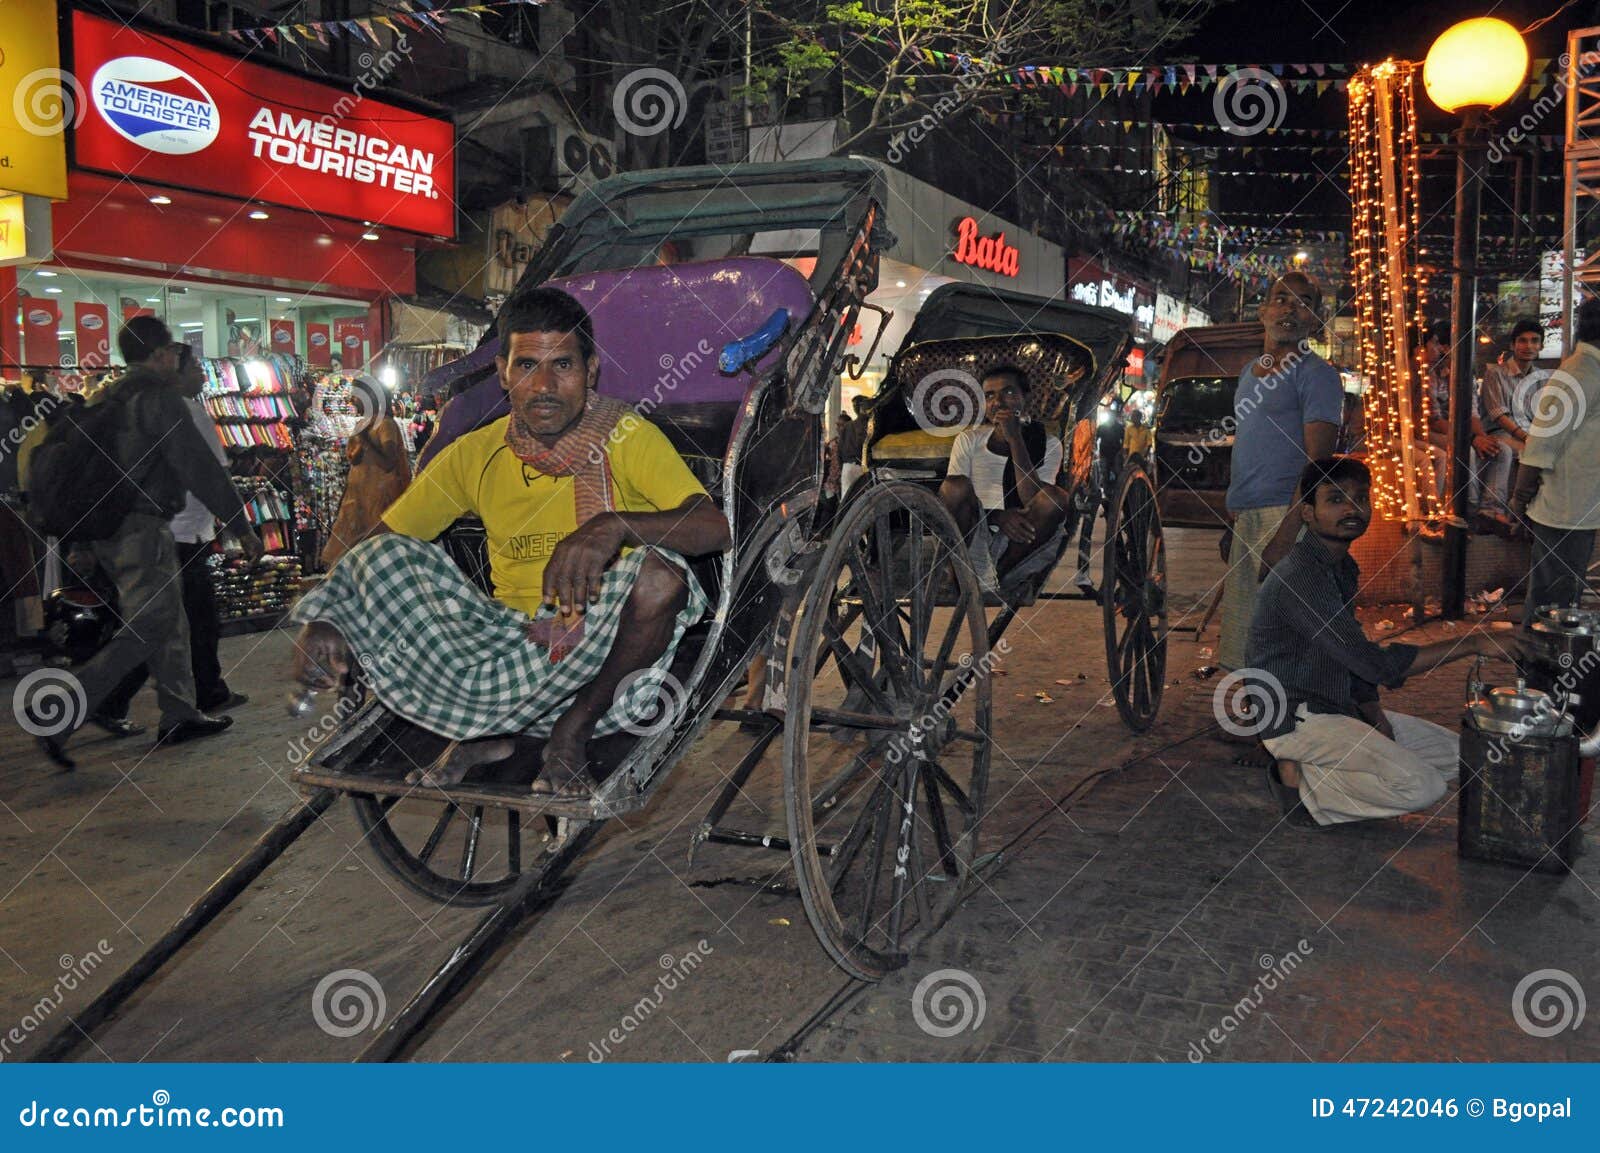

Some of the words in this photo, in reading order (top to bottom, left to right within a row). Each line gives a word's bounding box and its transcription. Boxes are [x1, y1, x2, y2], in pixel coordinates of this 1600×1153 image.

[101, 80, 211, 117] AMERICAN
[101, 92, 211, 130] TOURISTER
[248, 121, 437, 199] TOURISTER
[249, 97, 434, 175] AMERICAN
[954, 216, 1020, 278] Bata
[511, 532, 570, 559] NEE
